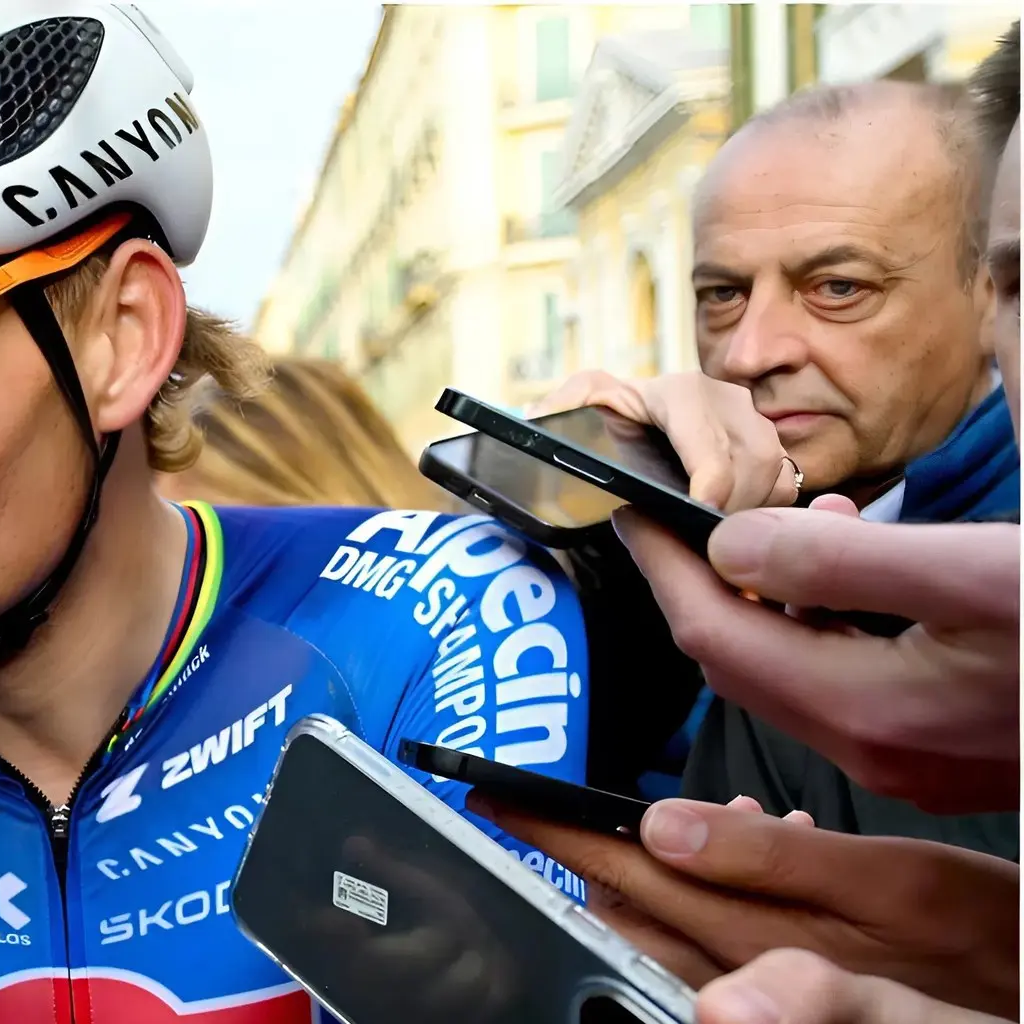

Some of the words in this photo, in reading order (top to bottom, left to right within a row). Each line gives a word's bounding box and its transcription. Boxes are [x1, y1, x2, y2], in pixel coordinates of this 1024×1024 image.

[1, 91, 199, 227] CANYON
[320, 545, 417, 600] DMG
[345, 509, 581, 767] Alpecin
[161, 683, 293, 790] ZWIFT
[96, 793, 264, 881] CANYO
